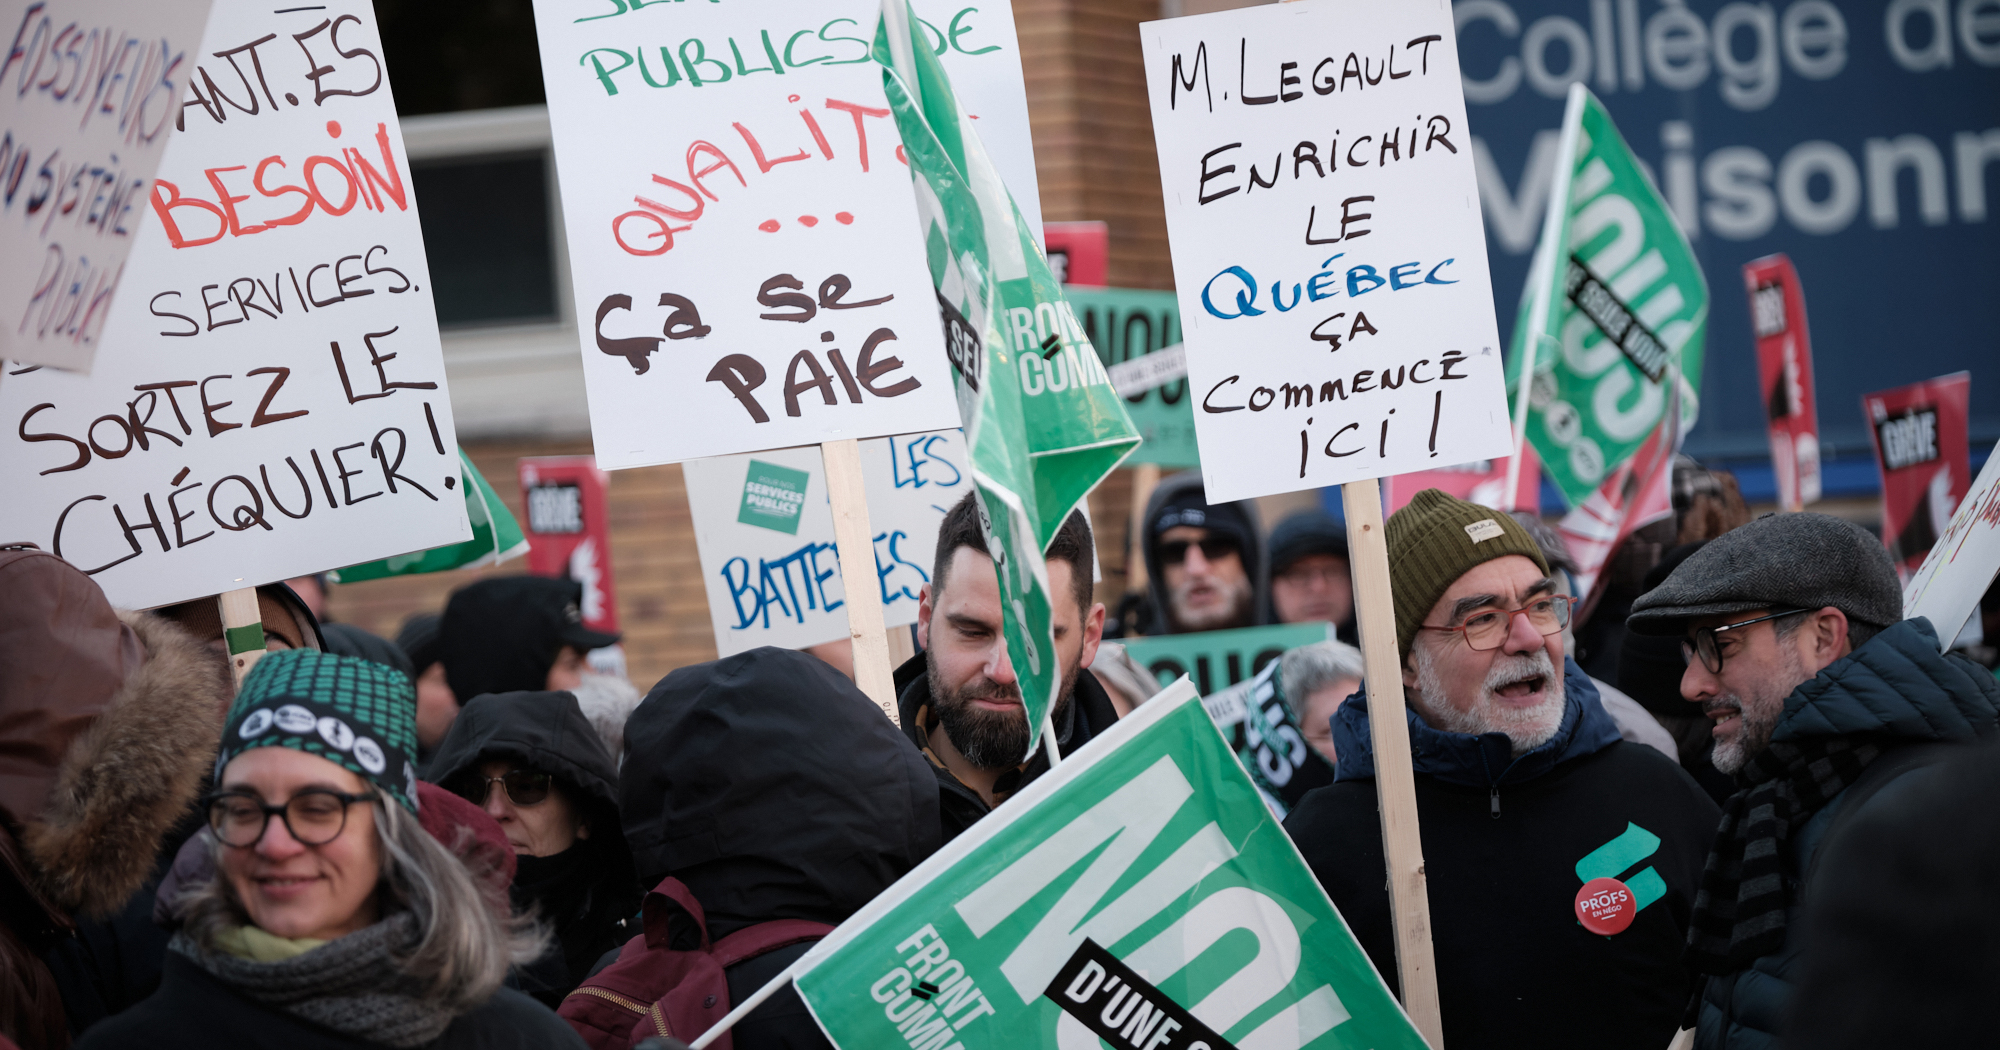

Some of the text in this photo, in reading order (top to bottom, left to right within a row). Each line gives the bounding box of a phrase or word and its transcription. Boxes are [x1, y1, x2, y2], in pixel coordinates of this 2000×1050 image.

[579, 18, 872, 96] PUBLICS
[1453, 0, 1850, 110] Collège
[612, 94, 910, 257] QUALIT
[1305, 195, 1376, 246] LE
[1200, 252, 1461, 320] QUÉBEC
[1310, 311, 1379, 352] ÇA
[1018, 343, 1107, 397] COM
[18, 326, 438, 476] SORTEZ LE
[888, 435, 963, 489] LES
[746, 481, 804, 504] SERVICES
[746, 494, 798, 515] PUBLICS
[721, 530, 930, 630] BATTEES
[1580, 890, 1627, 913] PROFS
[1592, 904, 1622, 918] EN NÉGO
[895, 923, 996, 1031] FRONT
